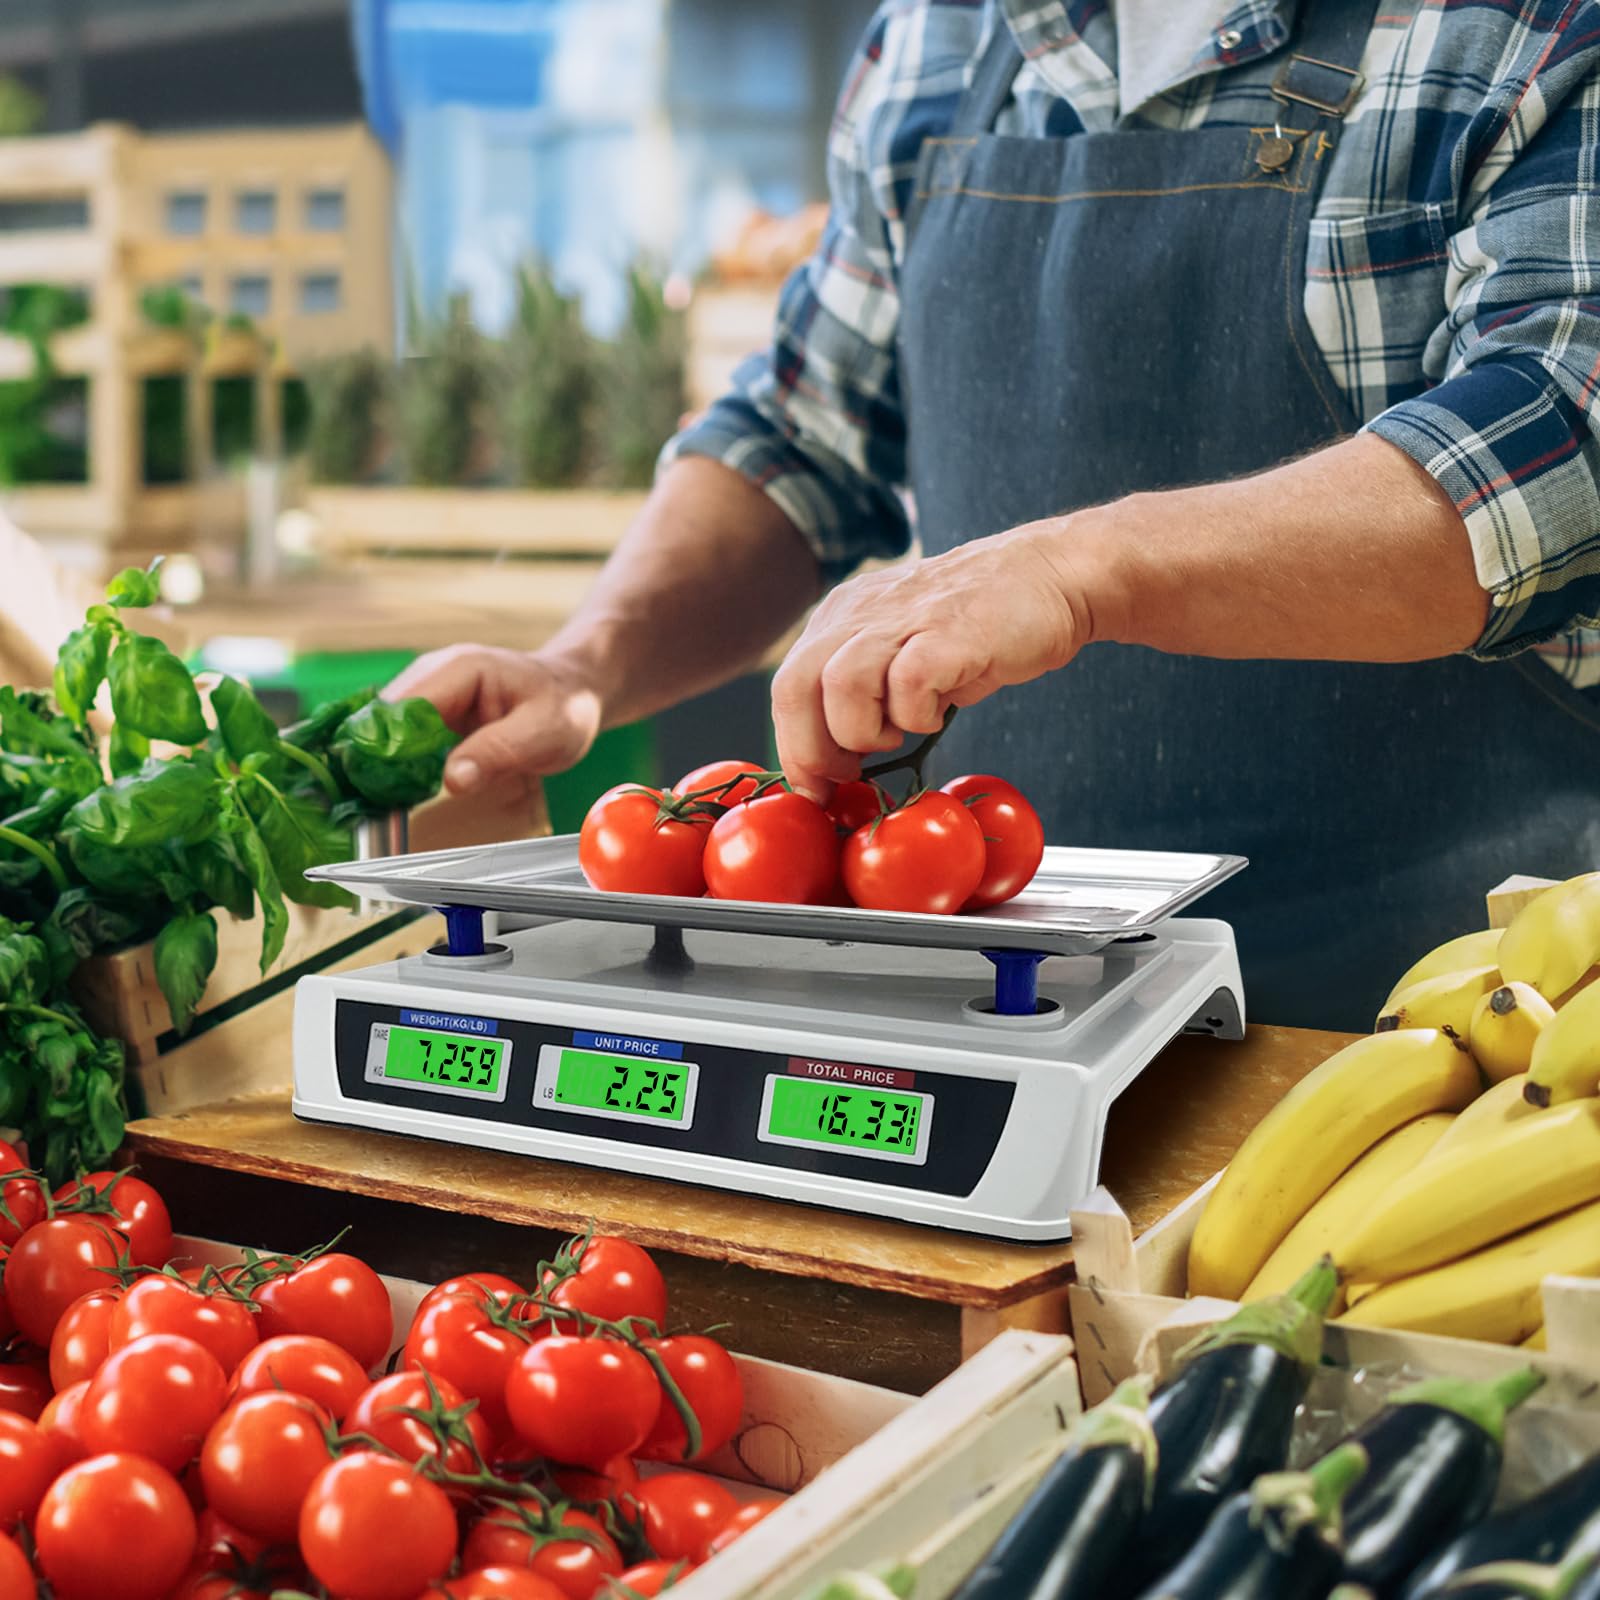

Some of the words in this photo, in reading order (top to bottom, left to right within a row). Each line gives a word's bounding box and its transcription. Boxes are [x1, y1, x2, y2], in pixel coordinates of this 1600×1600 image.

[409, 1014, 488, 1033] WEIGHT(KG/LB)
[374, 1028, 389, 1040] TARE
[594, 1037, 622, 1049] UNIT
[624, 1039, 659, 1054] PRICE
[373, 1066, 383, 1077] KG
[419, 1040, 496, 1085] 7.259
[806, 1063, 848, 1079] TOTAL
[854, 1069, 895, 1085] PRICE
[543, 1087, 554, 1099] LB
[605, 1066, 680, 1113] 2.25
[818, 1094, 909, 1145] 16.33
